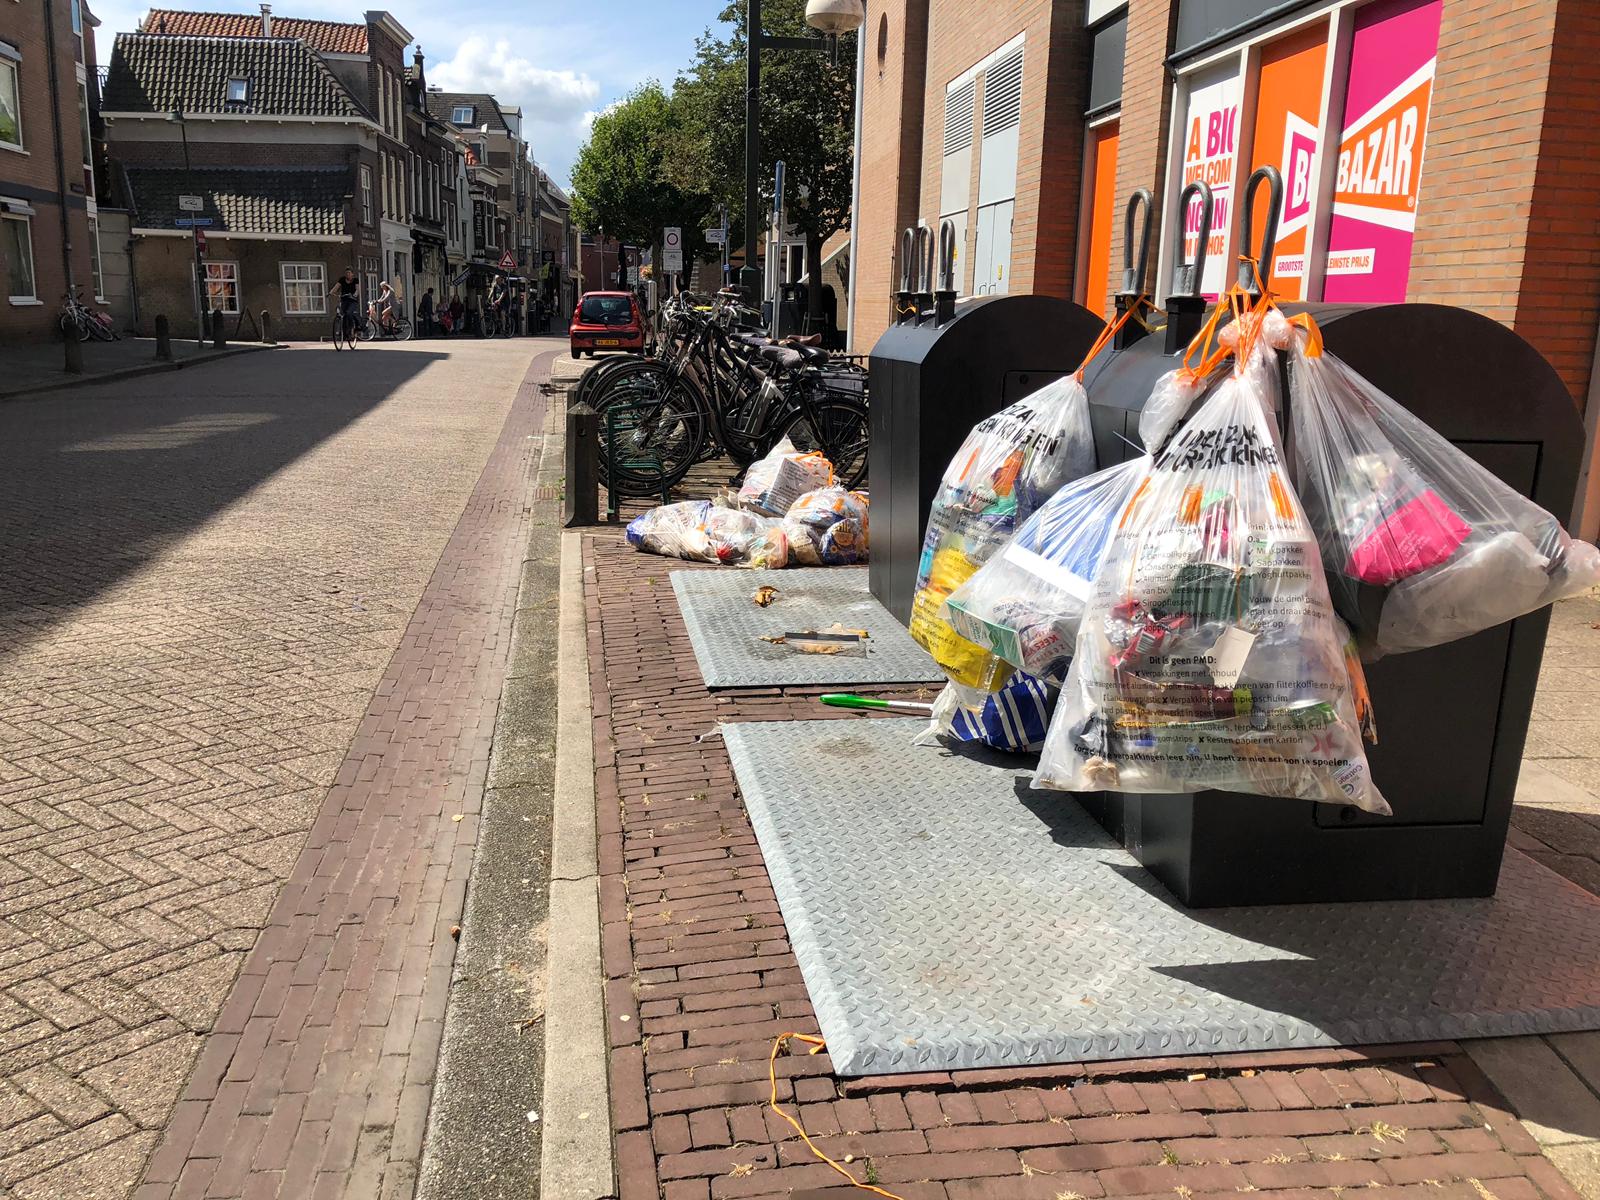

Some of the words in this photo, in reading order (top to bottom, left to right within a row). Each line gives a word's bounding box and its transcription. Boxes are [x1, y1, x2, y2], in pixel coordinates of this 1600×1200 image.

[1187, 117, 1200, 162] A
[1336, 106, 1418, 195] BAZAR
[1351, 256, 1370, 268] PRIJS
[1149, 656, 1161, 665] Dit
[1162, 656, 1169, 664] is
[1171, 658, 1192, 666] geen
[1206, 735, 1233, 743] Resten
[1276, 735, 1303, 743] karton
[1312, 758, 1351, 767] spoelen.
